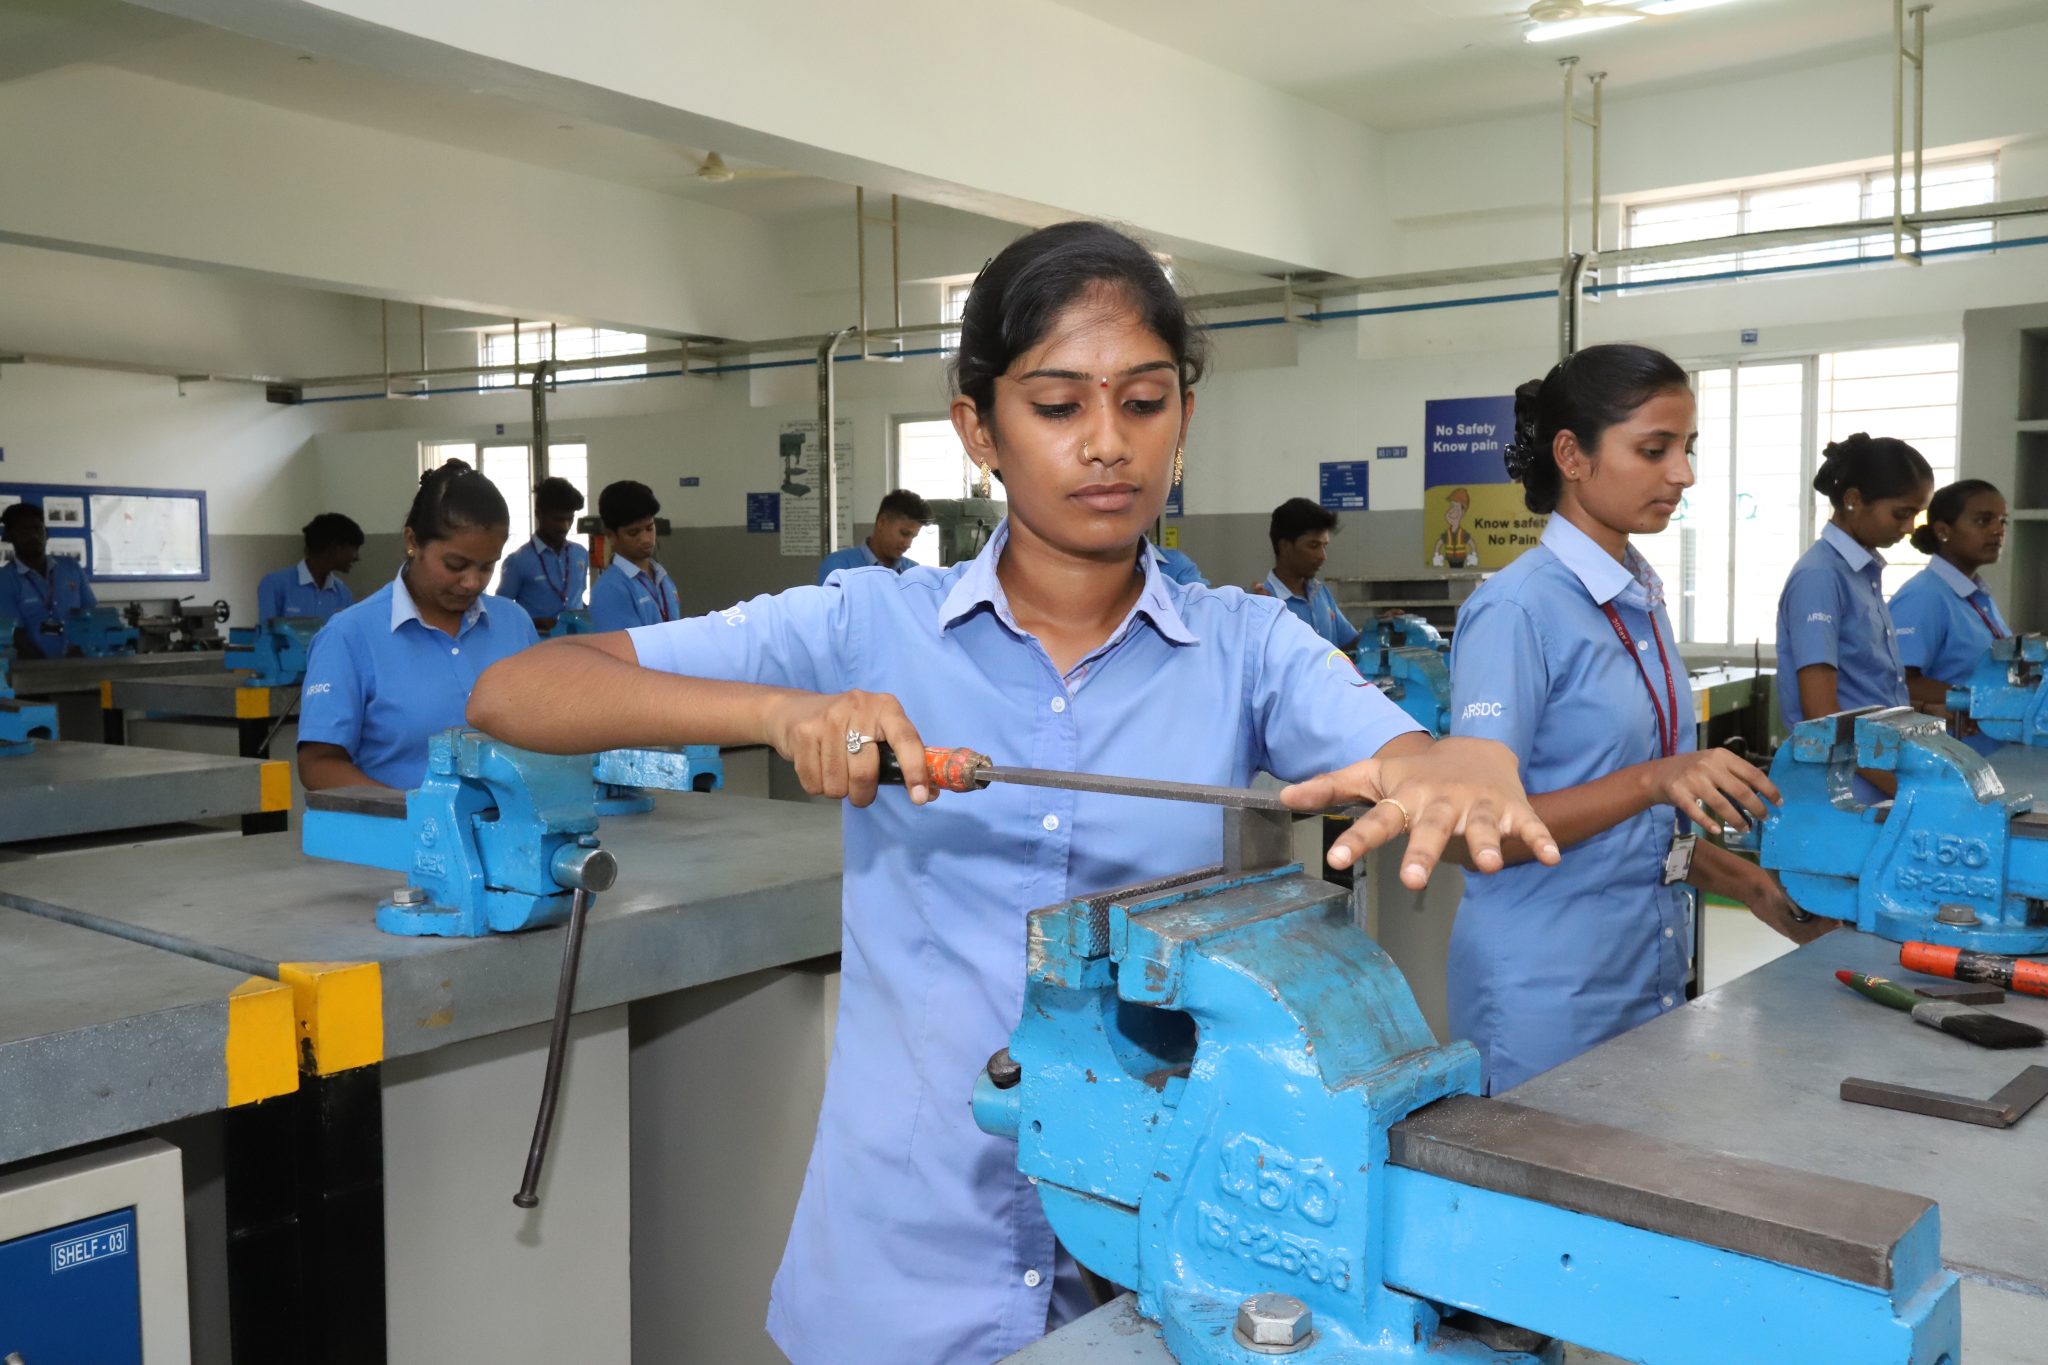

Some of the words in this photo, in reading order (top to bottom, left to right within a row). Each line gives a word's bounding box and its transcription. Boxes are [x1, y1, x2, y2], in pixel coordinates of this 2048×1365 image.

[1436, 424, 1453, 436] No
[1456, 423, 1496, 437] Safety
[1433, 441, 1468, 453] Know
[1471, 439, 1498, 453] pain
[1474, 518, 1510, 529] Know
[1488, 534, 1505, 545] No
[1510, 534, 1537, 545] Pain
[1461, 702, 1502, 720] ARSDC
[1911, 829, 1990, 868] 150
[1219, 1132, 1341, 1228] 150
[57, 1239, 98, 1267] SHELF
[109, 1232, 123, 1252] 03
